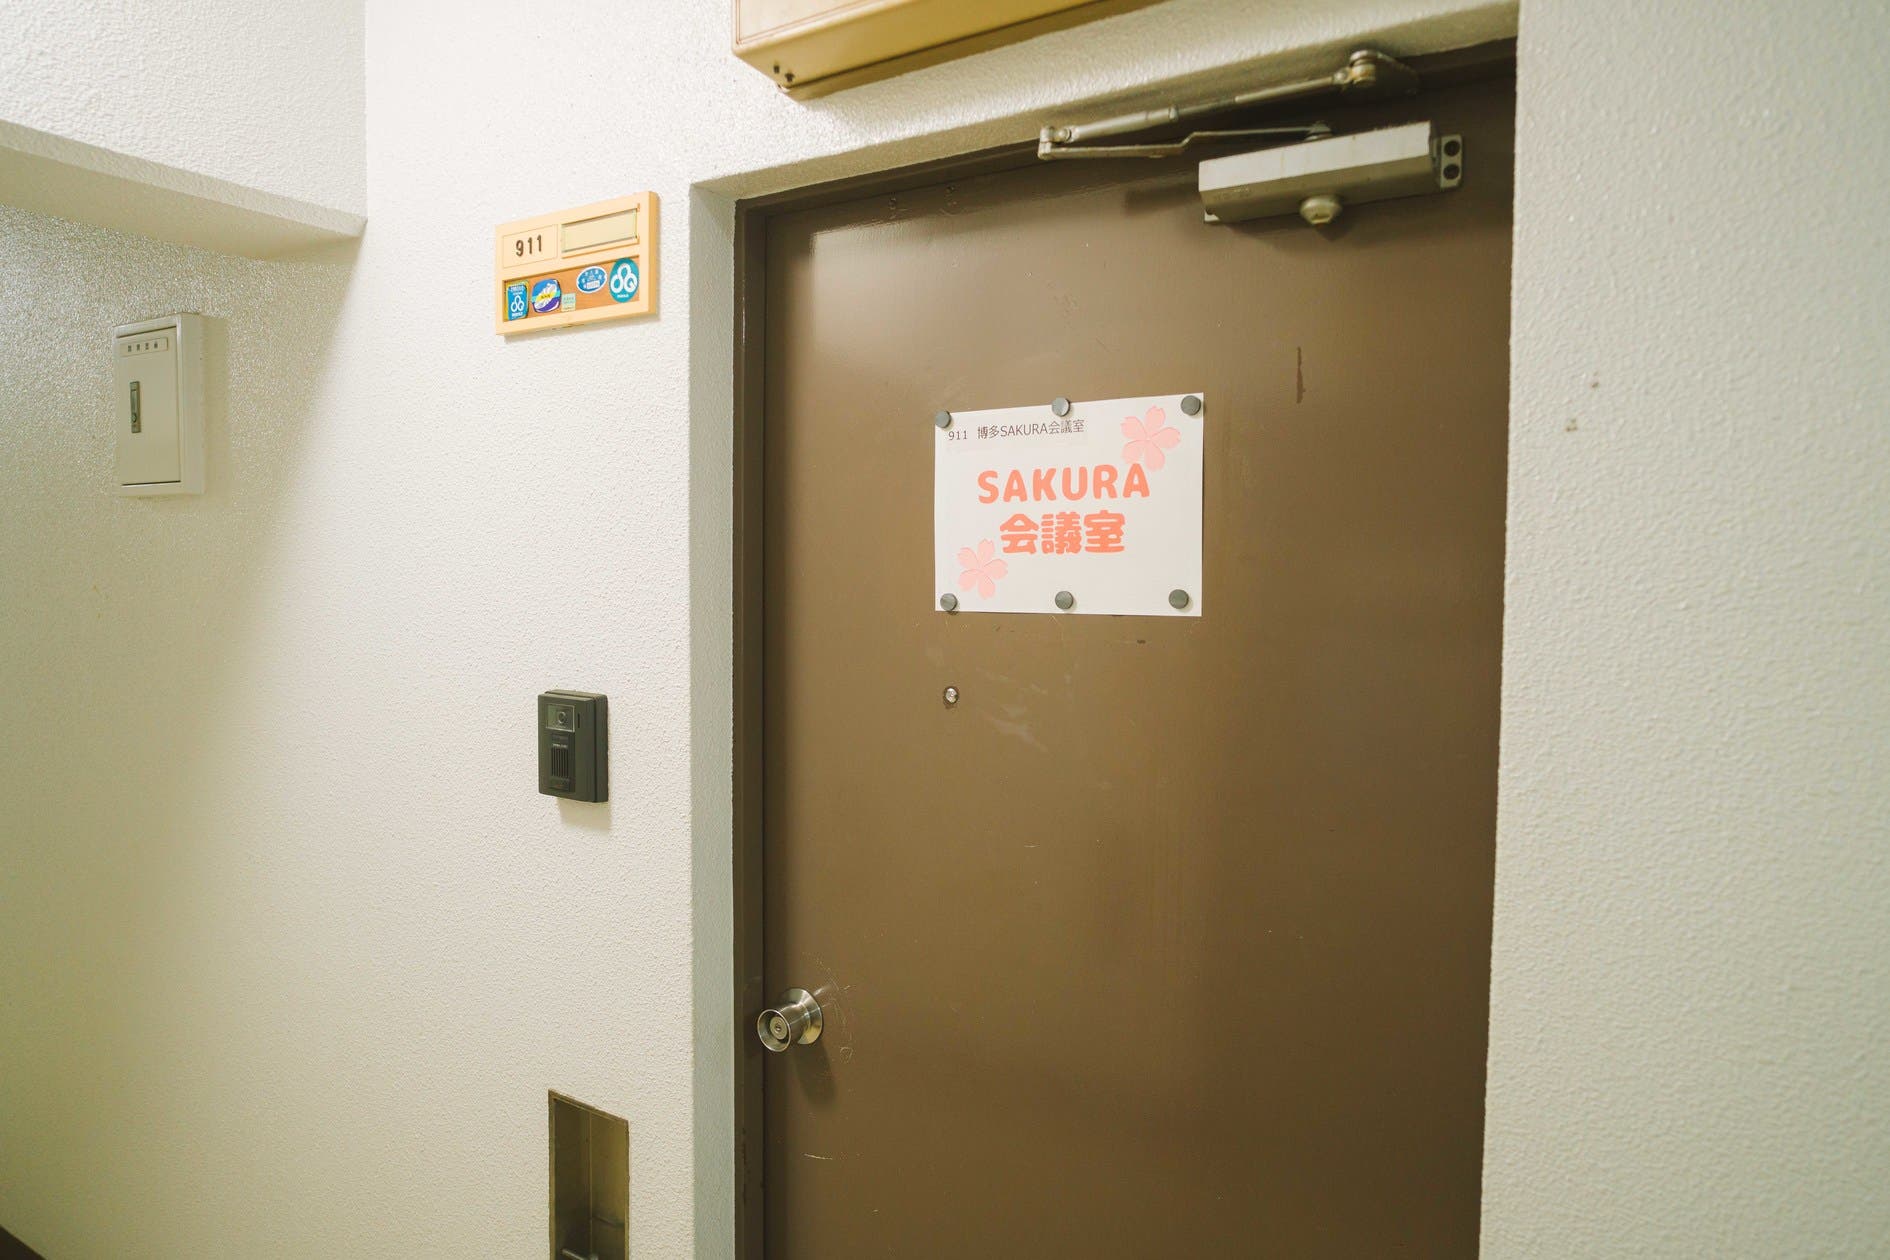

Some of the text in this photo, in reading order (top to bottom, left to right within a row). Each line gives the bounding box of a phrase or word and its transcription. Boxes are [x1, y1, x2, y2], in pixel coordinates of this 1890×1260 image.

[516, 234, 542, 257] 911
[947, 419, 1086, 441] 911 博多SAKURA会議室
[977, 462, 1150, 504] SAKURA
[999, 509, 1126, 555] 会議室
